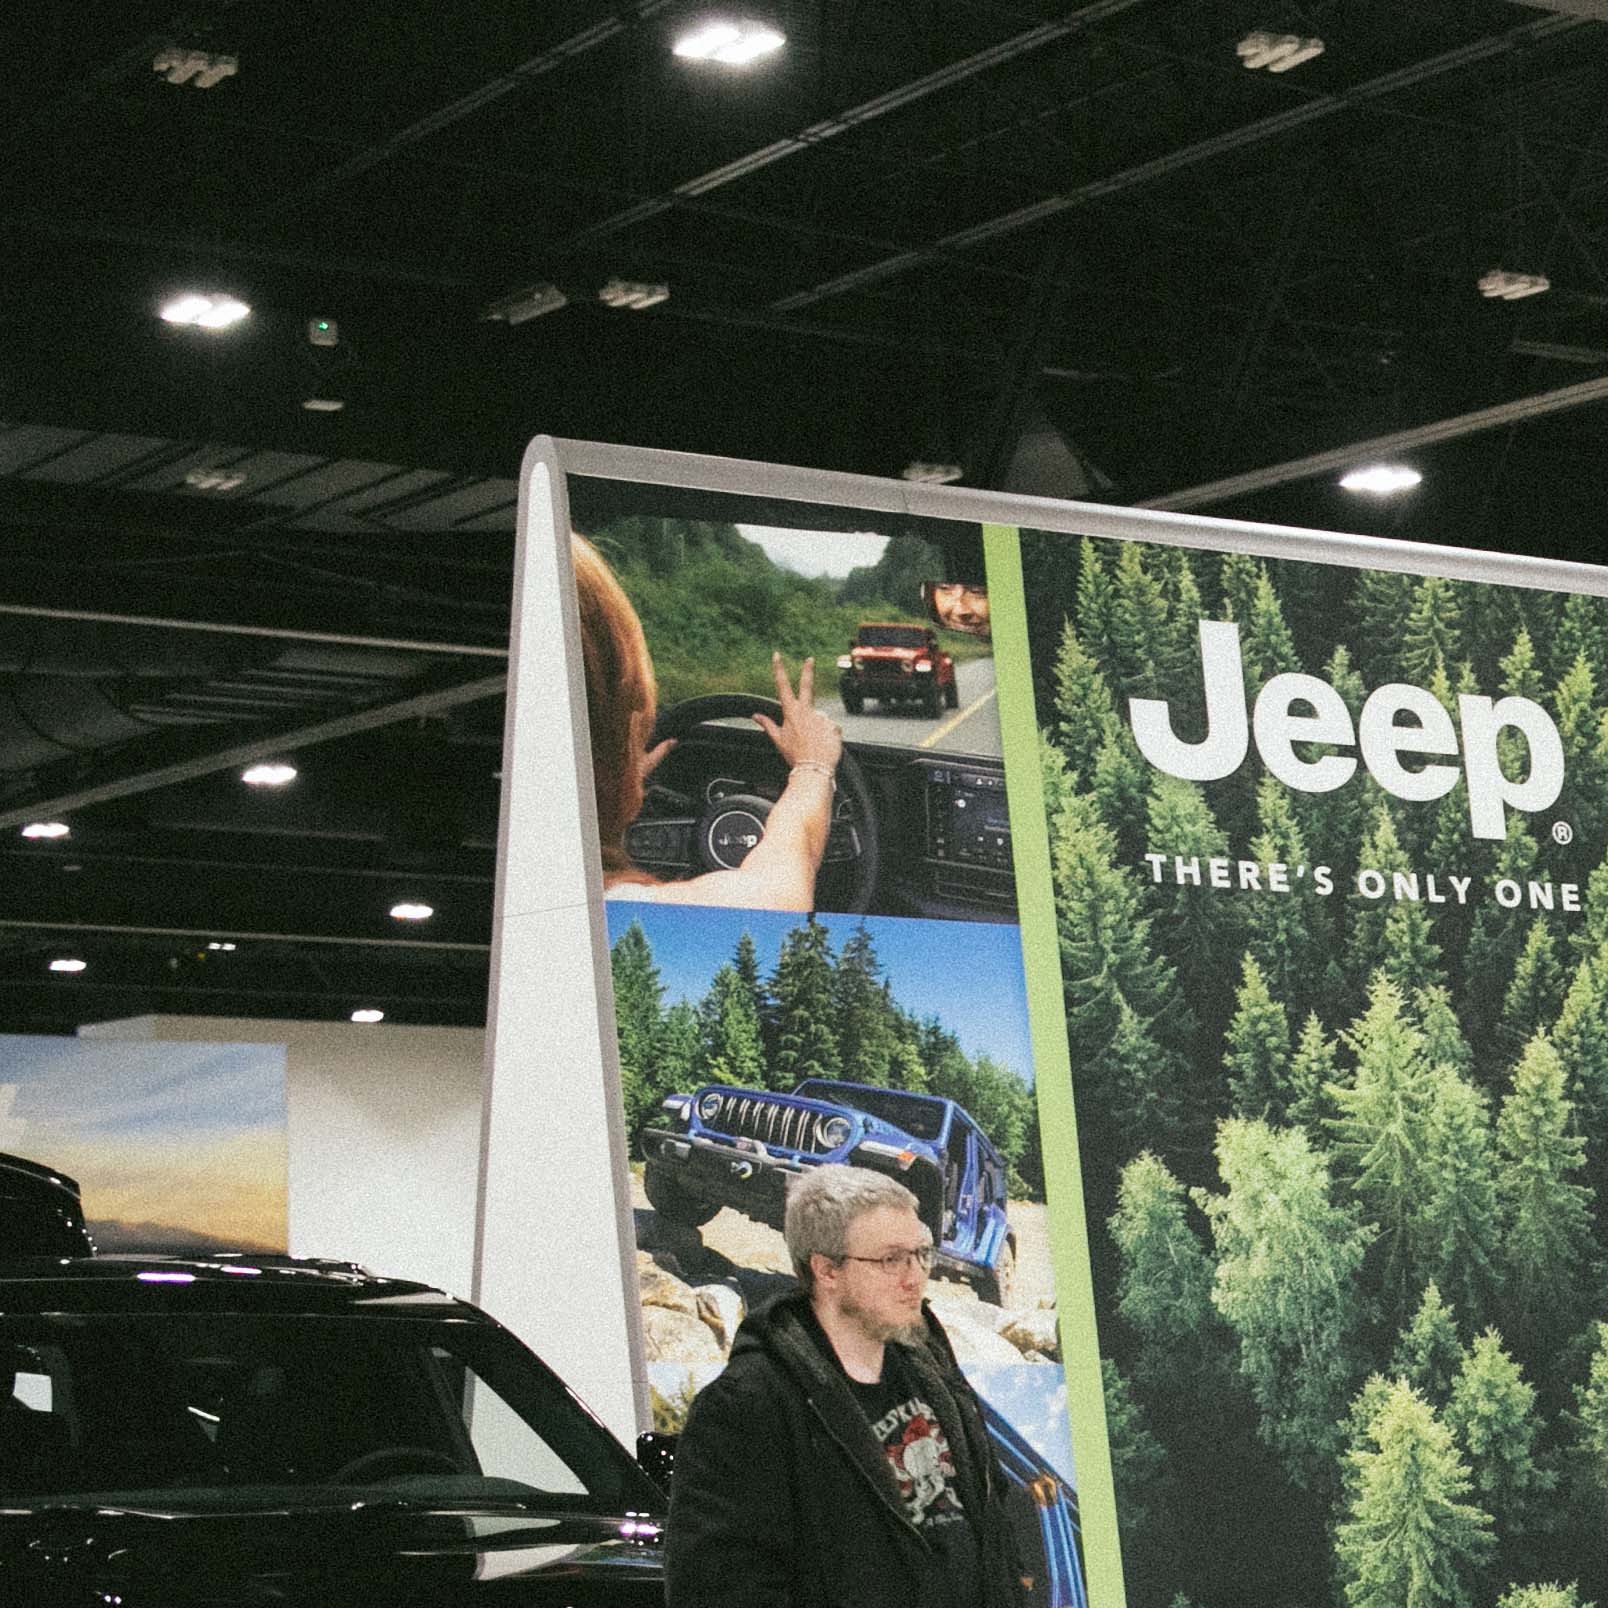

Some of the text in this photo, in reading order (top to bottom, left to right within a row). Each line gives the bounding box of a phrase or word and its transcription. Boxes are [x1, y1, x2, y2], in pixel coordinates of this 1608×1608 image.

[1128, 618, 1566, 841] Jeep
[1144, 853, 1582, 913] THERE'S ONLY ONE
